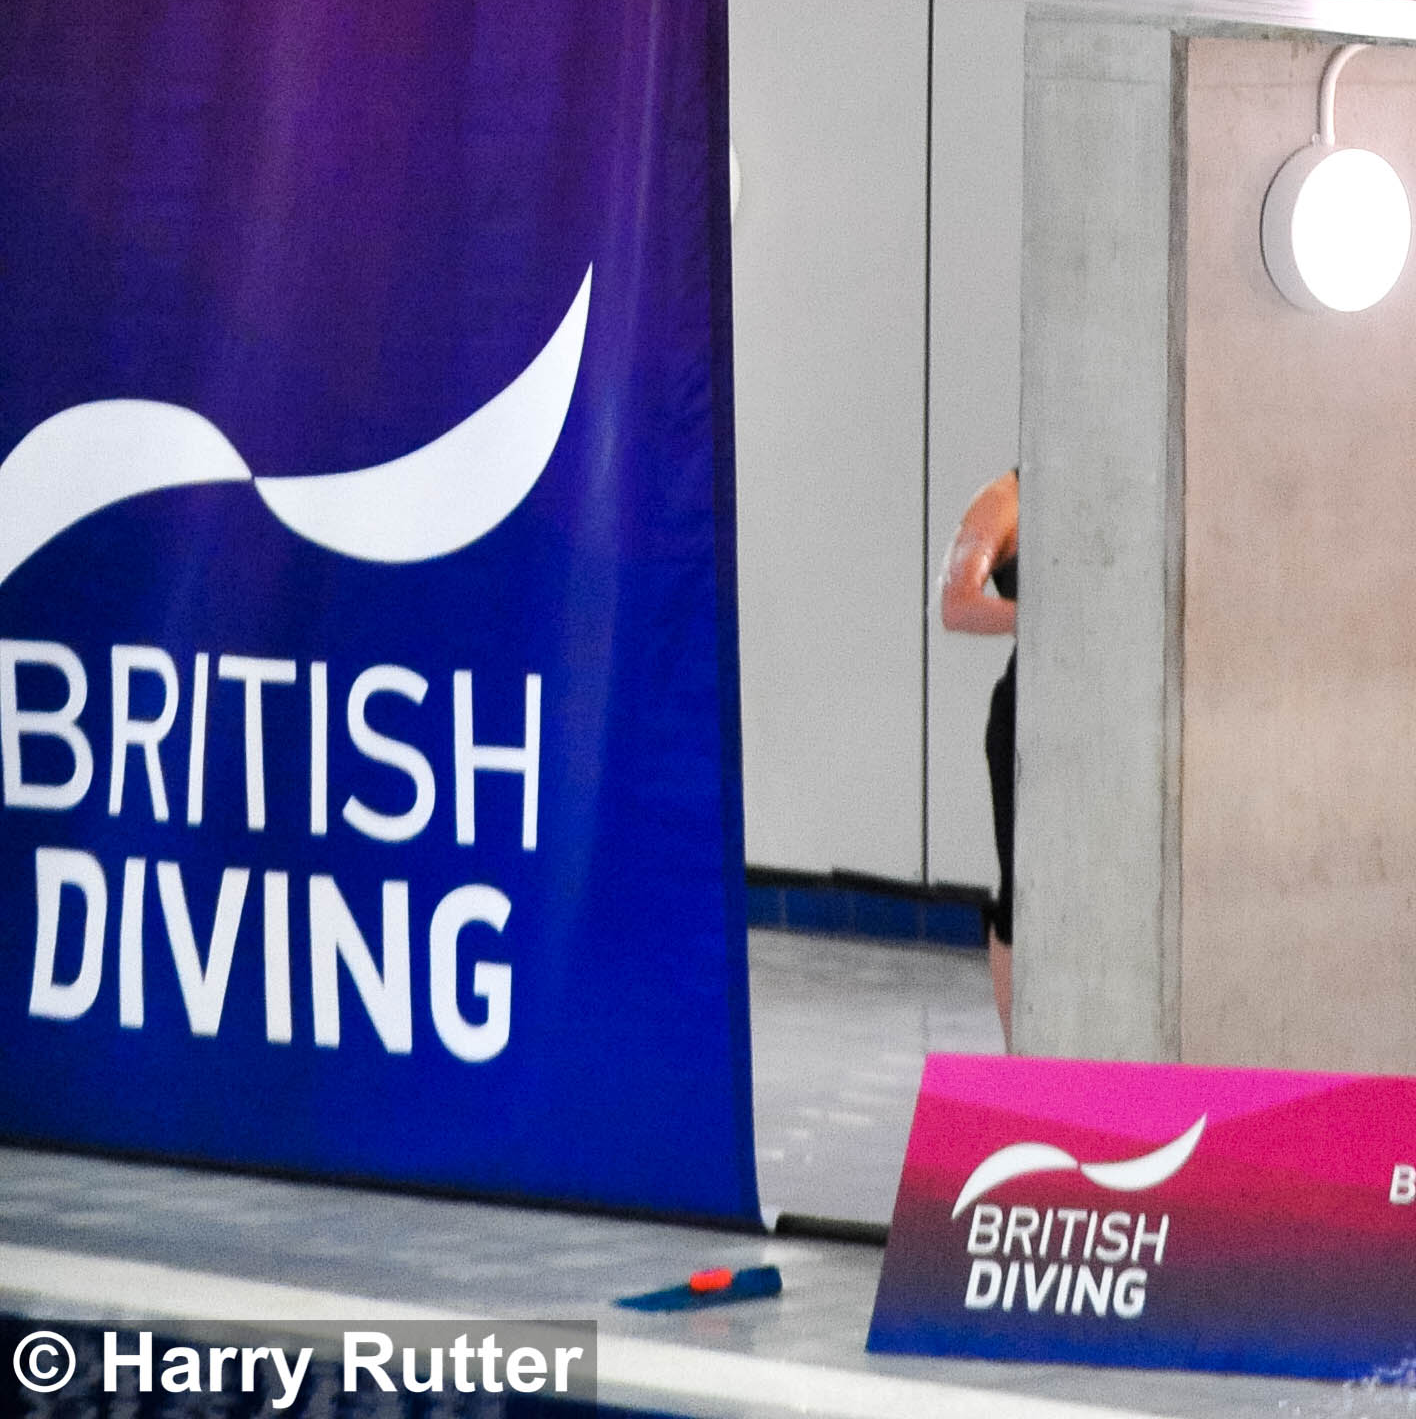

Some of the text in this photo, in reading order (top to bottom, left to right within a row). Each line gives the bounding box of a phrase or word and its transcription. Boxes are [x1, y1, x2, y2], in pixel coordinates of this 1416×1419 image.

[0, 639, 542, 851] BRITISH
[28, 847, 513, 1064] DIVING
[964, 1260, 1148, 1319] DIVING
[967, 1204, 1169, 1263] BRITISH
